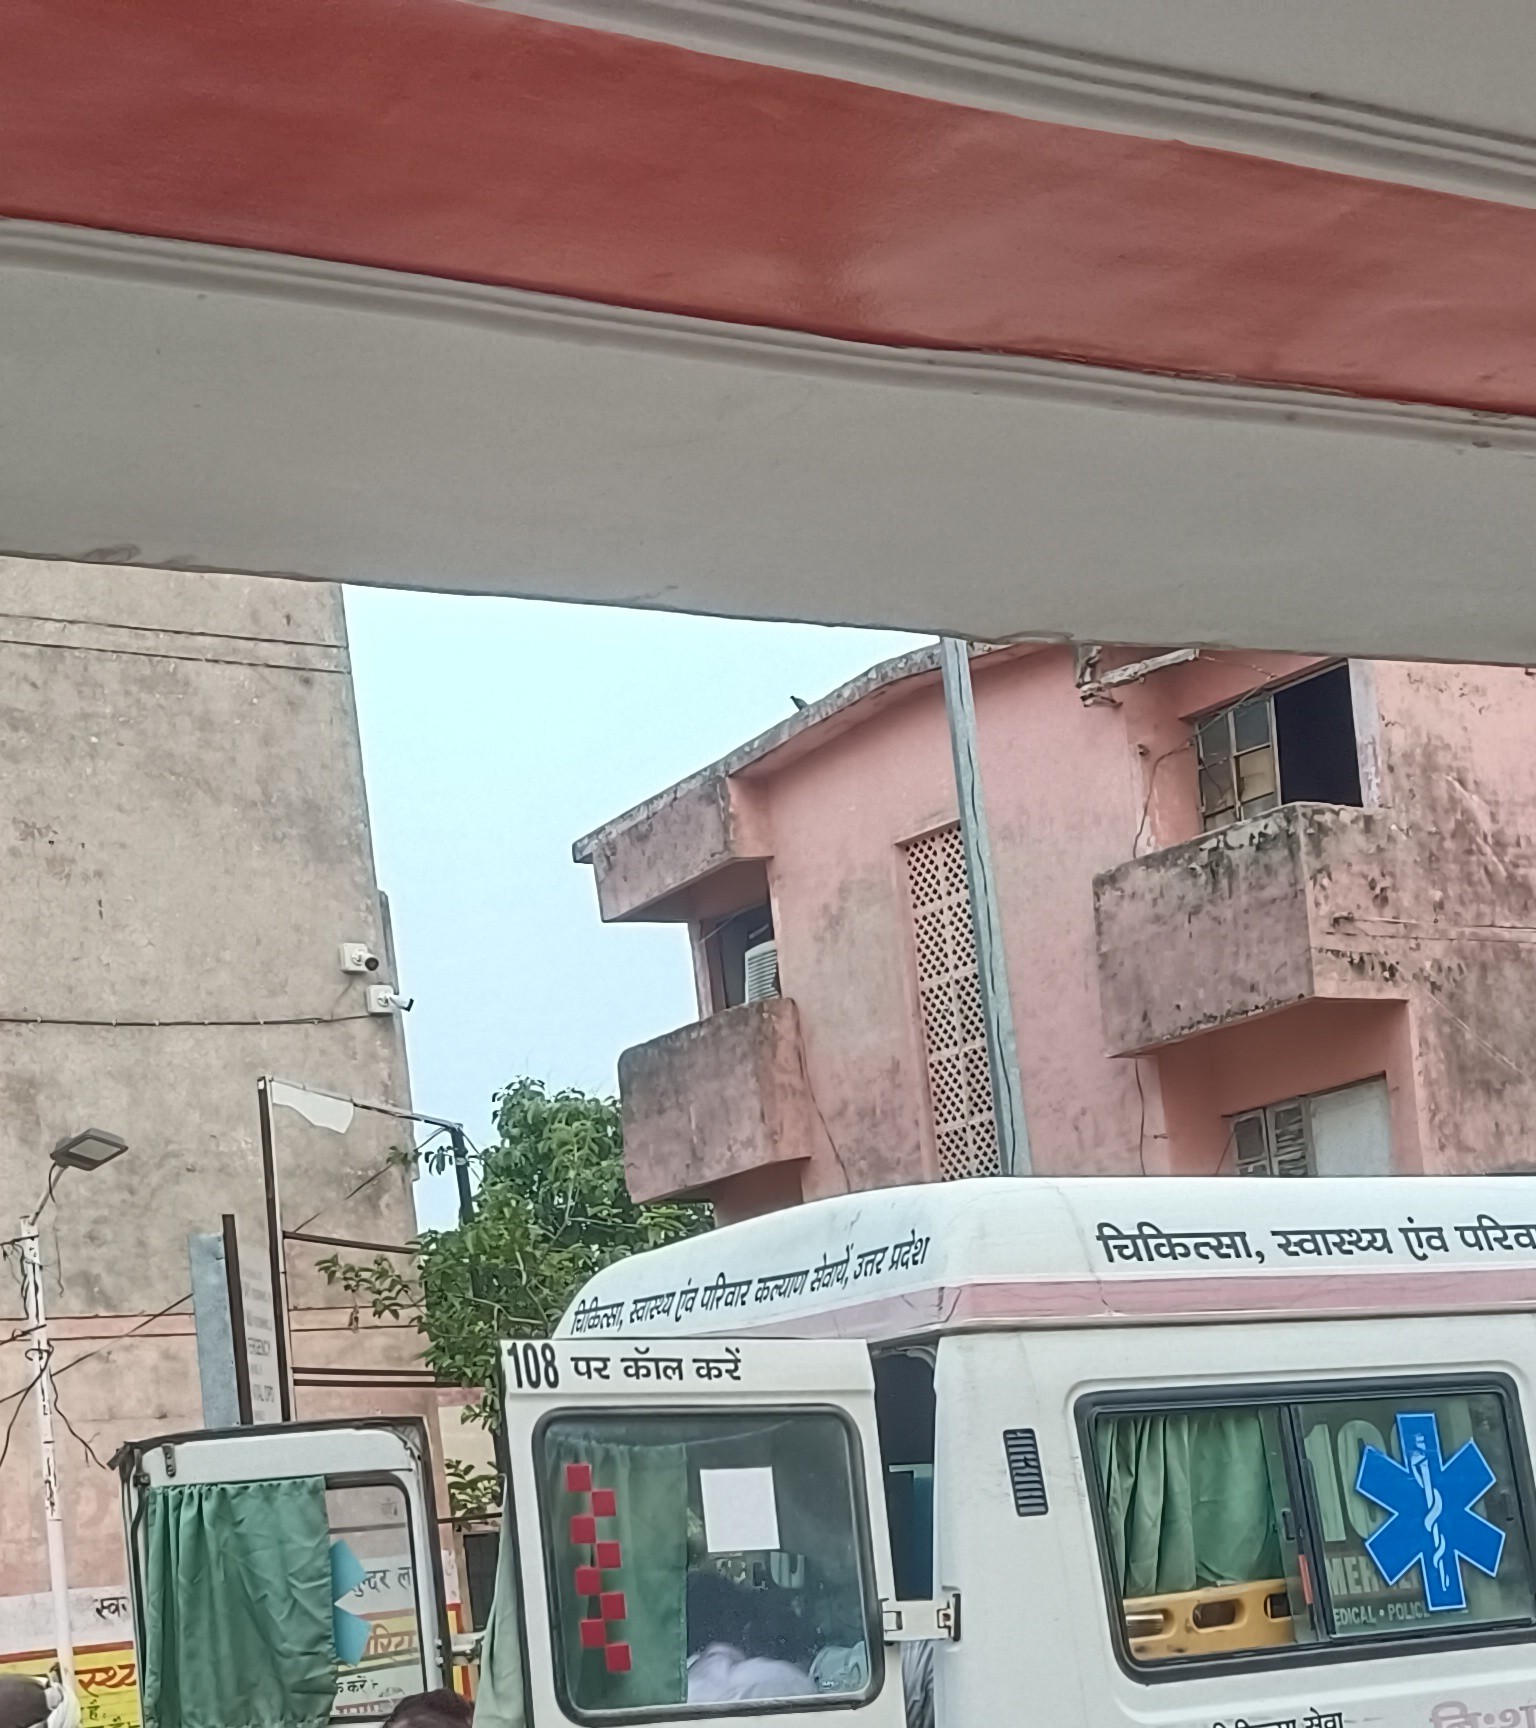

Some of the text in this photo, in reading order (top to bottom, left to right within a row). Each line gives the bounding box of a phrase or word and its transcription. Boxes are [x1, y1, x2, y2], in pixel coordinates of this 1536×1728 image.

[1096, 1221, 1265, 1264] चिकित्सा,
[1270, 1226, 1394, 1257] स्वास्थ्य
[571, 1296, 624, 1335] चिकित्सा,
[629, 1291, 676, 1323] स्वास्थ्य
[700, 1272, 752, 1311] परिवार
[754, 1269, 810, 1303] कल्याण
[853, 1246, 889, 1280] उत्तर
[888, 1228, 931, 1271] प्रदेश
[507, 1340, 742, 1389] 108 पर कॉल करें
